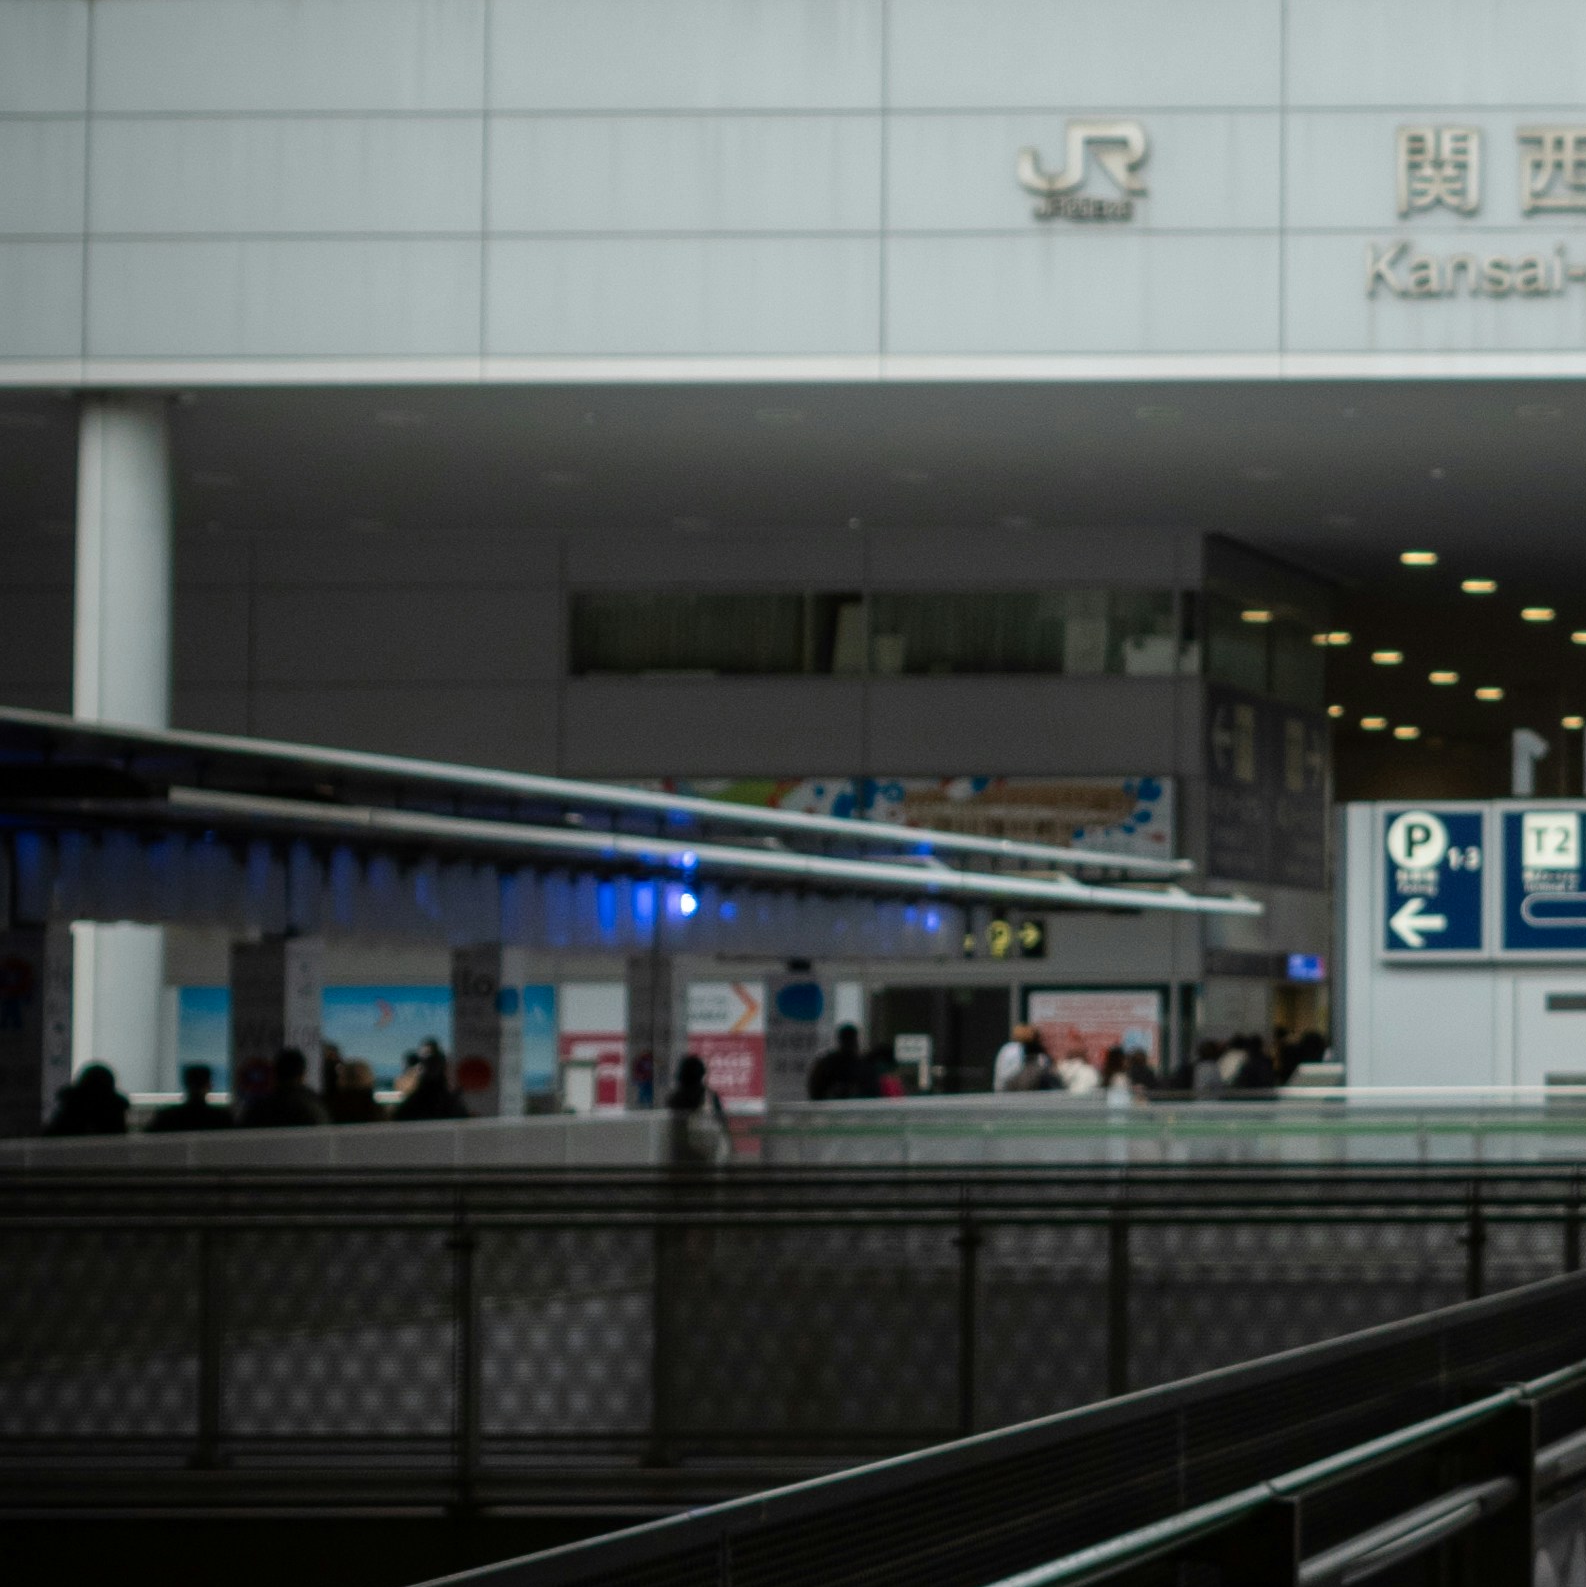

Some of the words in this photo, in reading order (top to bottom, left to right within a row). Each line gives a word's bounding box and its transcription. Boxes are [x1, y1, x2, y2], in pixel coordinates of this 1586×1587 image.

[1018, 120, 1150, 195] JR
[1405, 823, 1432, 858] P
[1530, 825, 1571, 854] T2
